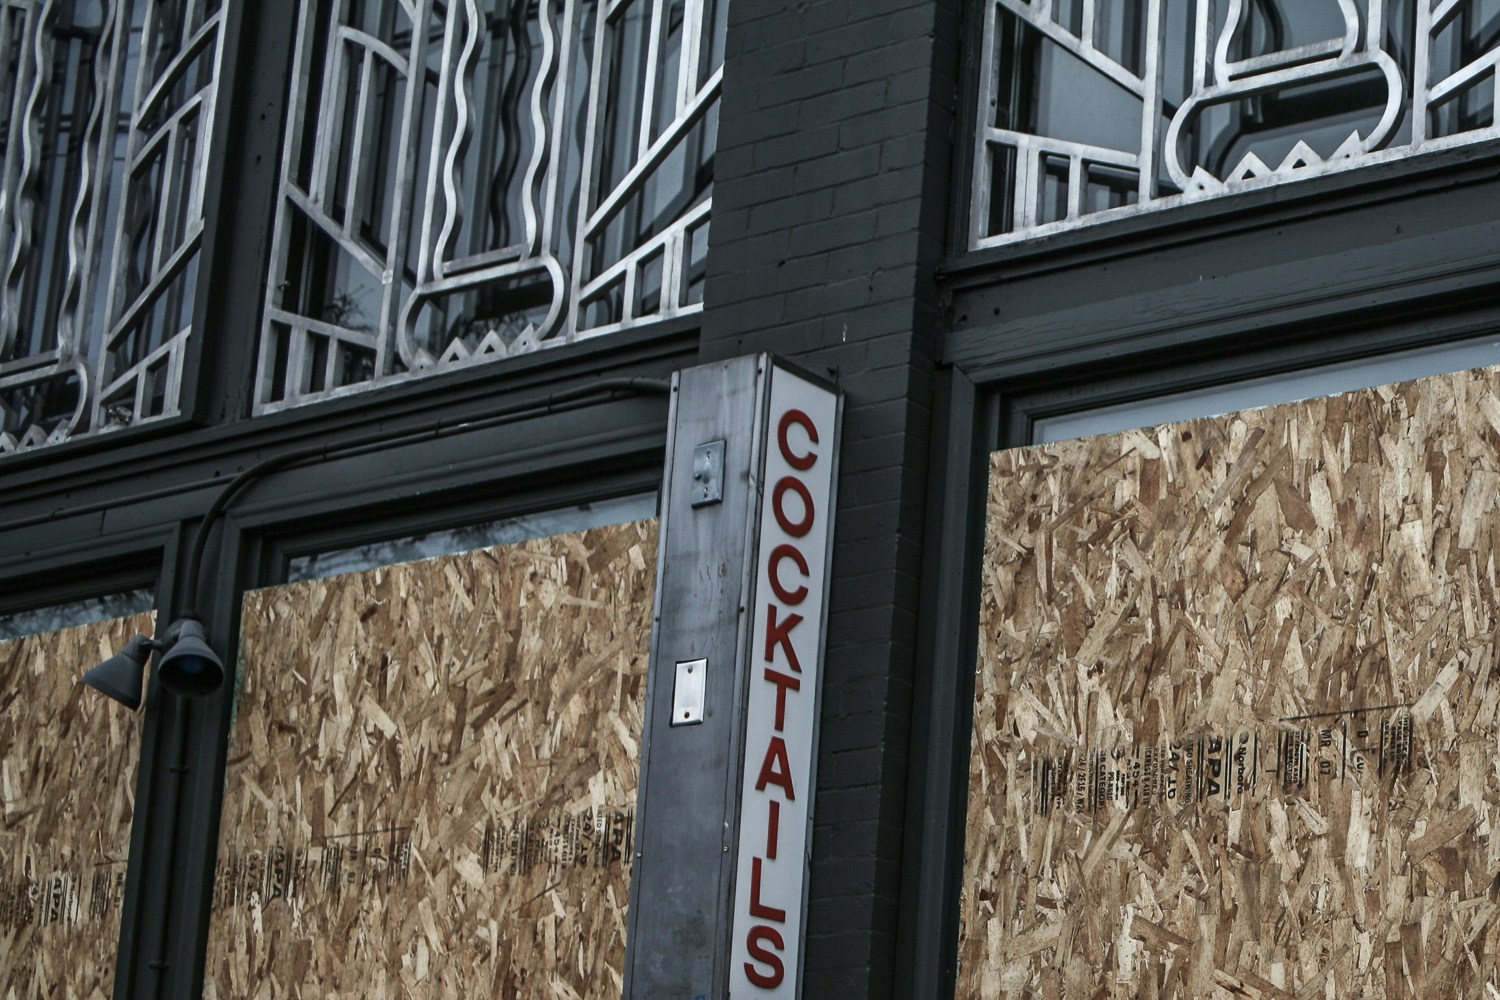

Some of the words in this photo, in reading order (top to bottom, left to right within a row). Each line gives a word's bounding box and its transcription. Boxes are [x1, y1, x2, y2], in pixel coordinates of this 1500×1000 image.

[743, 409, 819, 990] COCKTAILS
[1320, 729, 1332, 747] MR
[1077, 773, 1086, 791] 2F16
[1184, 760, 1192, 803] SHEATHING
[1207, 737, 1222, 797] APA
[1237, 747, 1247, 794] Norbord
[1320, 761, 1330, 775] 07
[610, 811, 624, 862] APA
[273, 853, 285, 898] APA
[50, 878, 62, 923] APA
